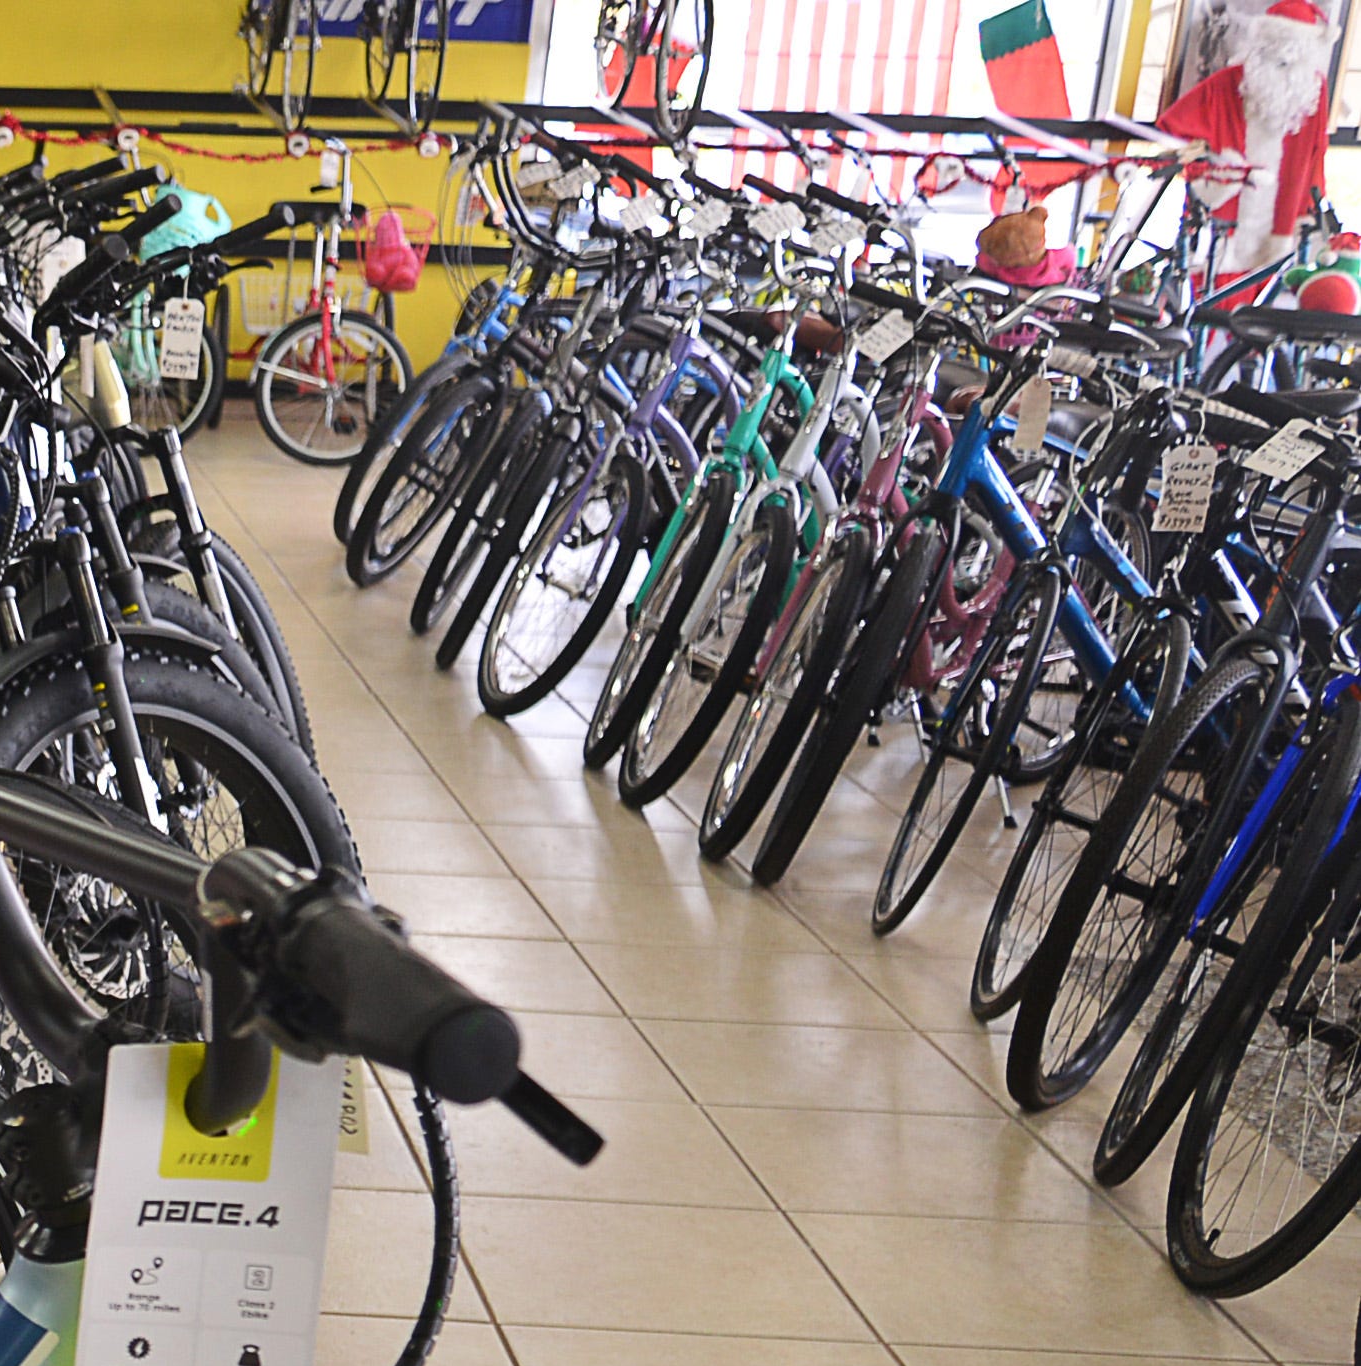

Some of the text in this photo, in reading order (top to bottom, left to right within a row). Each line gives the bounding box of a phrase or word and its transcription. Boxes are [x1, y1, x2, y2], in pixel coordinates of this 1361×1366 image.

[1170, 462, 1211, 471] GIANT
[177, 1153, 253, 1167] AVENTON
[128, 1292, 161, 1302] Range
[238, 1299, 275, 1310] Class 2
[241, 1310, 269, 1319] Ebike
